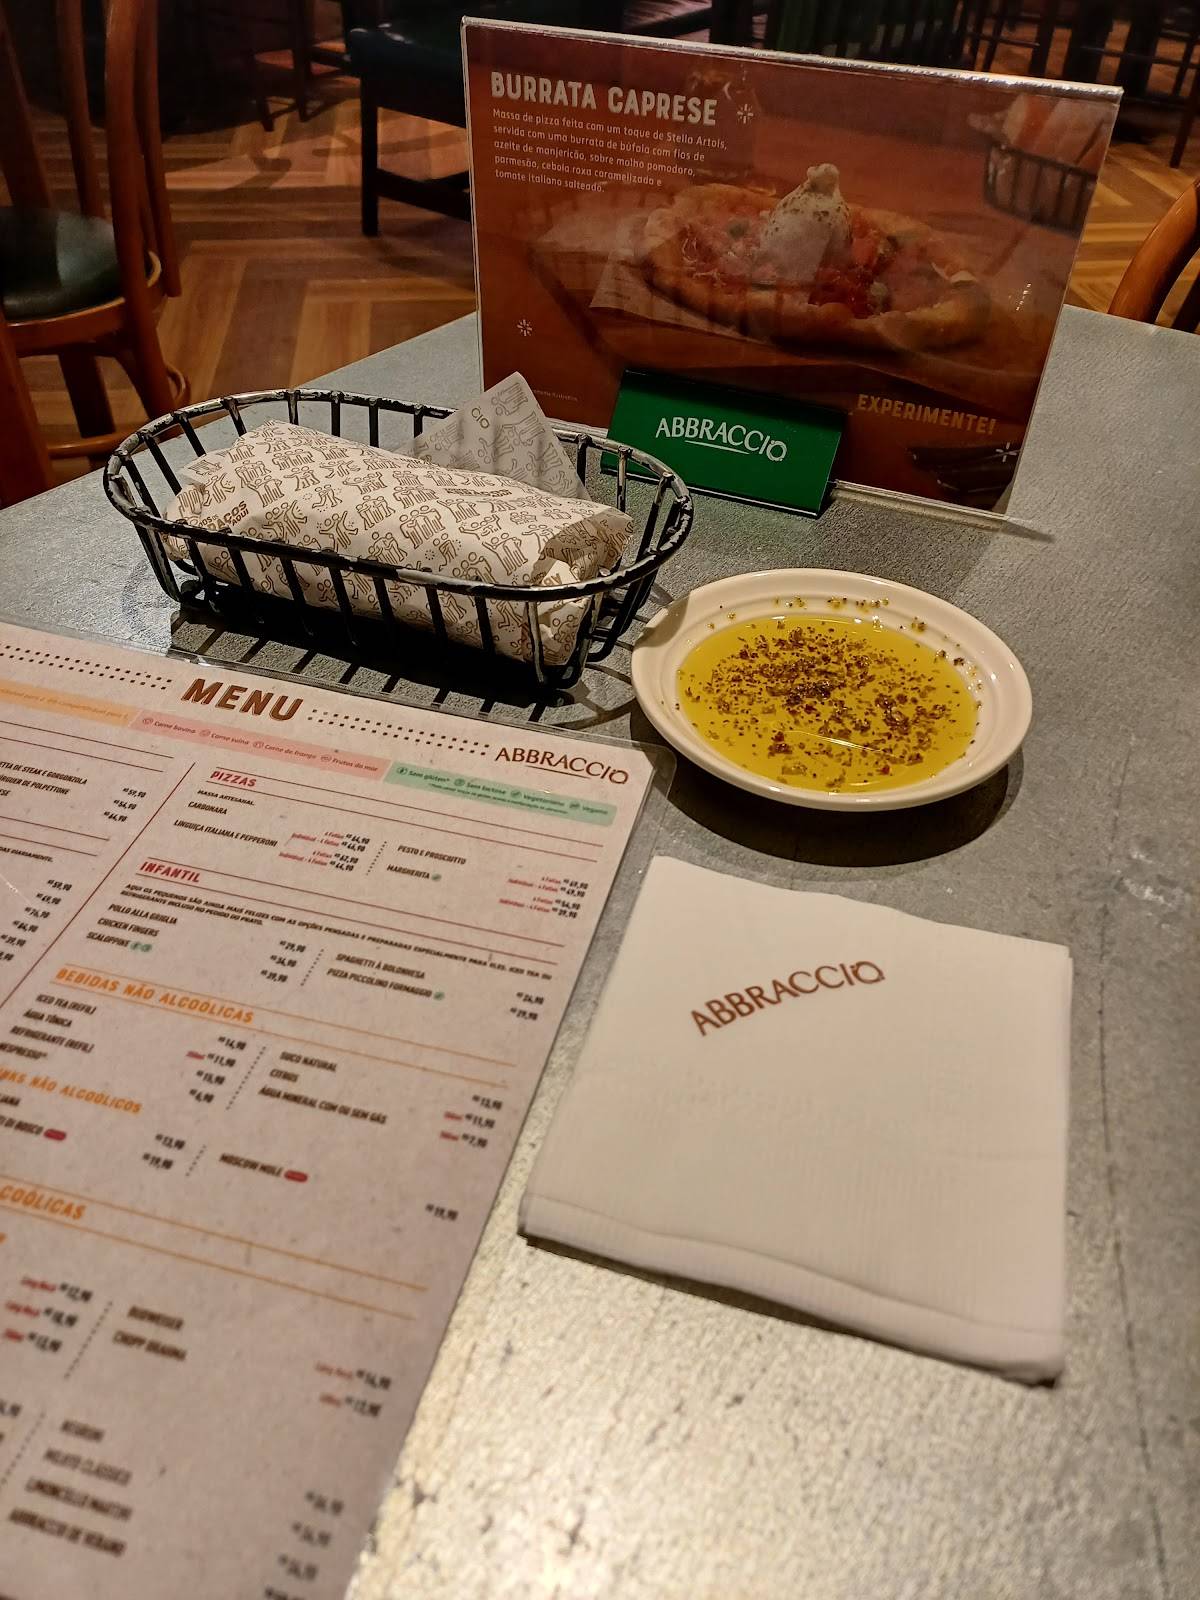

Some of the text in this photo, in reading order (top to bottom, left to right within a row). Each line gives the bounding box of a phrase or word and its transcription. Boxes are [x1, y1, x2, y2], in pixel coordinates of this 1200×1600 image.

[491, 71, 717, 126] BURRATA CAPRESE
[493, 108, 728, 151] Massa de pizza feita com um toque de Stella Artois,
[494, 125, 705, 162] servida com uma burrata de búfala com fios de
[494, 140, 696, 177] azeite de manjericão, sobre molho pomodoro,
[494, 155, 539, 170] parmesão,
[542, 161, 570, 173] cebola
[572, 167, 592, 177] roxa
[656, 179, 662, 187] e
[495, 168, 526, 181] tomate
[528, 172, 562, 187] italiano
[857, 394, 997, 435] EXPERIMENTE!
[656, 416, 788, 462] ABBRACCIO
[180, 678, 304, 722] MENU
[22, 766, 41, 776] STEAK
[209, 771, 258, 786] PIZZAS
[495, 747, 630, 786] ABBRACCIO
[187, 801, 228, 814] CARBONARA
[172, 820, 205, 831] LINGUIÇA
[203, 826, 235, 837] ITALIANA
[239, 833, 278, 846] PEPPERONI
[397, 845, 419, 854] PESTO
[140, 862, 202, 882] INFANTIL
[386, 864, 431, 879] MARGHERITA
[108, 904, 130, 914] POLLO
[130, 909, 150, 918] ALLA
[97, 918, 159, 936] CHICKEN FINGERS
[336, 953, 376, 967] SPAGHETTI
[55, 969, 120, 992] BEBIDAS
[122, 981, 157, 1000] NÃO
[327, 968, 432, 996] PIZZA PICCOLINO FORMAGGIO
[690, 961, 886, 1037] ABBRACCIO
[280, 1052, 337, 1071] SUCO NATURAL
[29, 1074, 59, 1091] NÃO
